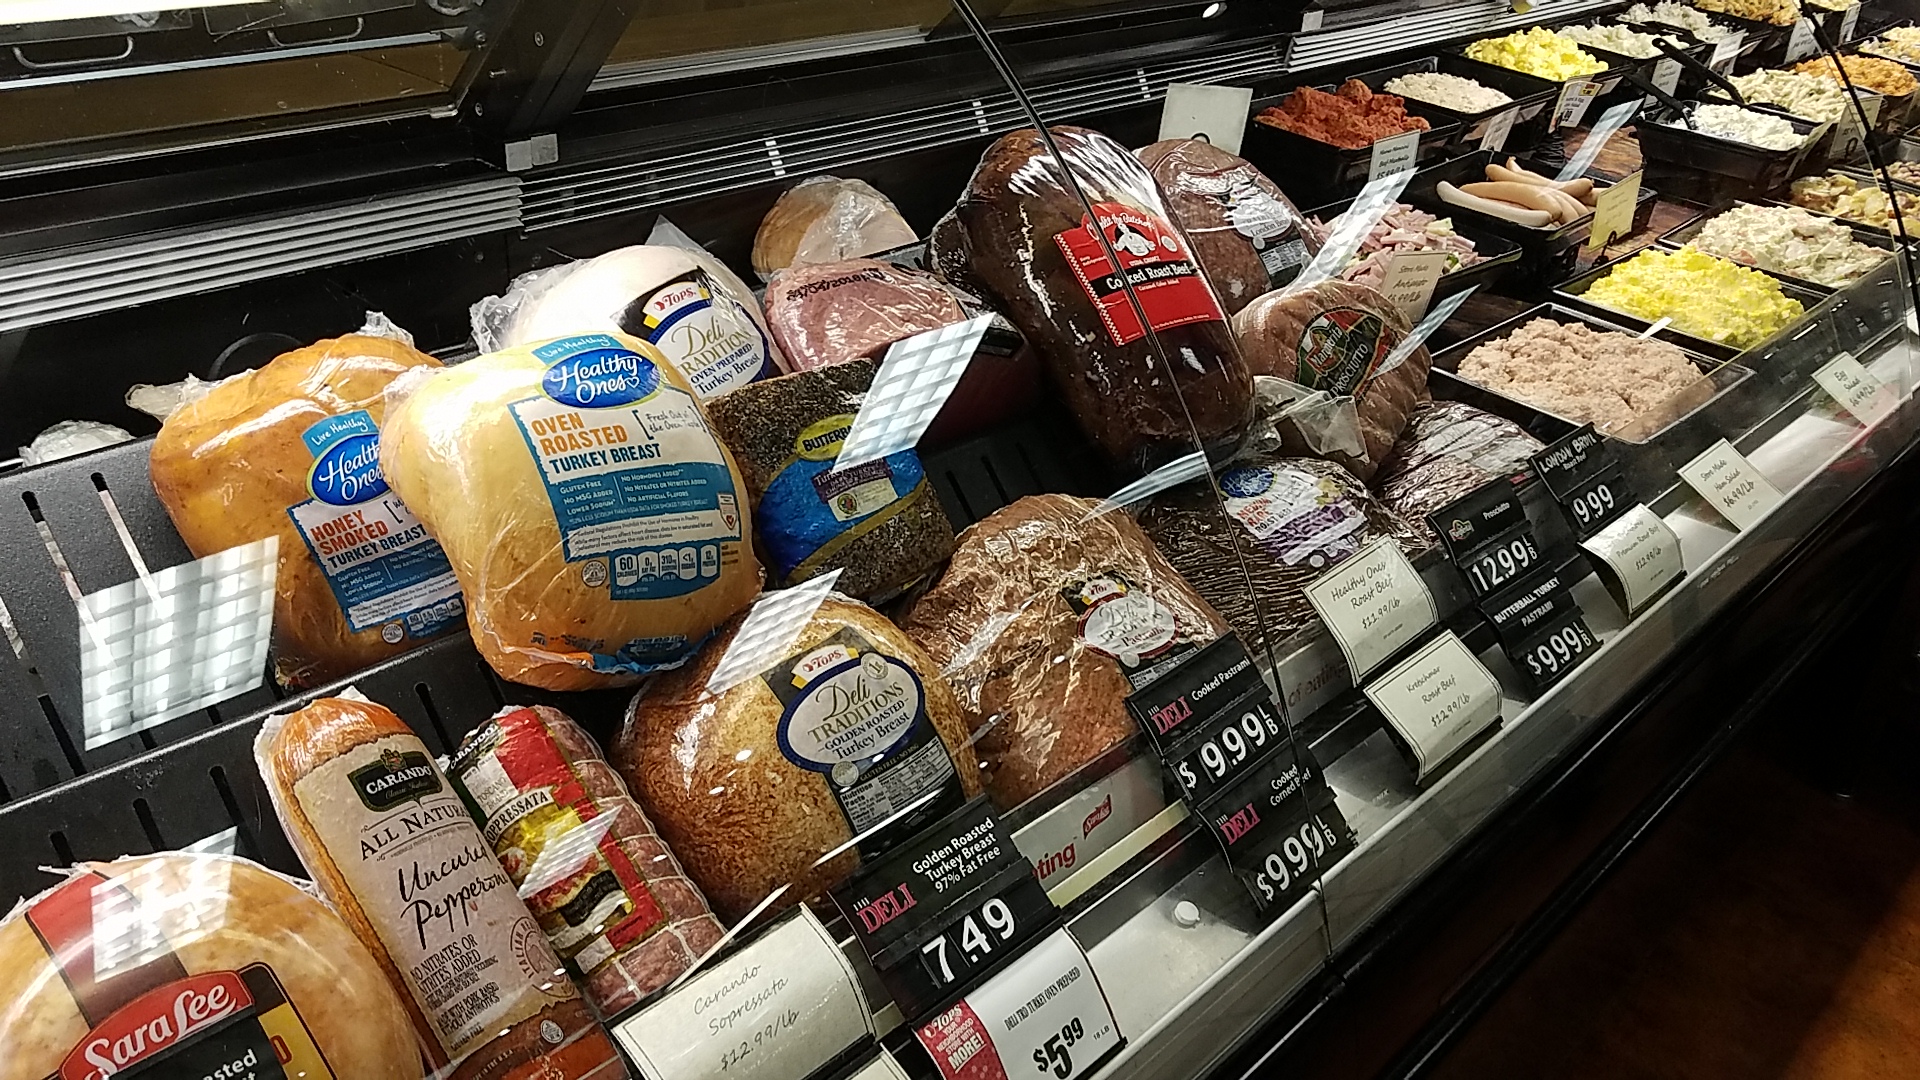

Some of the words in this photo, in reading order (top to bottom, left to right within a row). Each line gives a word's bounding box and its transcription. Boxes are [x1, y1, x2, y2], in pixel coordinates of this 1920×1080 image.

[1250, 223, 1277, 238] London
[1106, 269, 1147, 290] Coked
[1145, 265, 1173, 280] Roast
[1170, 262, 1192, 277] Beef
[541, 345, 562, 358] Live
[671, 315, 725, 361] Deli
[677, 330, 753, 376] RADITION
[550, 355, 643, 392] Healthy
[690, 365, 716, 385] OVEN
[716, 344, 753, 371] PREPARED
[695, 369, 735, 395] Turkey
[735, 352, 762, 374] Breast
[1329, 342, 1369, 399] PROSCIUTTO
[575, 376, 627, 404] Ones
[311, 431, 331, 446] Live
[531, 412, 585, 437] OVEN
[538, 424, 628, 457] ROASTED
[802, 425, 853, 452] BUTTERB
[318, 437, 380, 493] Healt
[548, 451, 609, 475] TURKEY
[612, 443, 662, 464] BREAST
[1539, 445, 1574, 474] LONDON
[1572, 432, 1597, 453] BROIL
[341, 464, 386, 501] Ones
[1714, 476, 1729, 493] Ham
[1483, 502, 1510, 520] Prosciutto
[1573, 484, 1615, 524] 9.99
[310, 509, 365, 542] HONEY
[319, 520, 389, 556] SMOKED
[327, 542, 380, 570] TURKEY
[381, 524, 427, 551] BREAST
[619, 556, 632, 572] 60
[1471, 540, 1529, 592] 12.99
[1330, 575, 1366, 601] Healthy
[1366, 561, 1387, 579] Ones
[1350, 587, 1375, 610] Roast
[1374, 574, 1394, 593] Beef
[1493, 593, 1536, 624] BUTTERBALL
[1532, 576, 1561, 602] TURKEY
[1520, 600, 1555, 627] PASTRAMI
[1526, 626, 1584, 676] $9.99
[815, 674, 871, 722] Deli
[1191, 675, 1220, 702] Cooked
[1217, 657, 1252, 685] Pastrami
[1406, 665, 1441, 694] Kretschmar
[1421, 686, 1442, 704] Roast
[1440, 673, 1457, 692] Beef
[807, 681, 905, 744] TRADITIONS
[824, 724, 866, 752] GOLDEN
[867, 699, 905, 731] ROASTED
[1151, 696, 1193, 736] DELI
[450, 722, 497, 770] CARANDO
[832, 733, 876, 760] Turkey
[876, 710, 911, 739] Breast
[365, 764, 433, 796] CARANDO
[476, 776, 508, 804] TOSCANO
[841, 781, 875, 802] Nutrition
[1270, 781, 1298, 807] Corned
[1271, 763, 1299, 791] Cooked
[845, 795, 867, 809] Facts
[360, 826, 401, 862] ALL
[399, 804, 470, 836] NATURA
[1219, 802, 1261, 846] DELI
[912, 844, 954, 875] Golden
[950, 817, 996, 850] Roasted
[924, 854, 964, 883] Turkey
[961, 832, 998, 861] Breast
[1256, 821, 1326, 902] $9.99
[398, 832, 493, 903] Uncured
[934, 871, 961, 894] 97%
[958, 858, 979, 879] Fat
[976, 846, 1002, 867] Free
[399, 867, 509, 950] Pepperoni
[856, 882, 918, 935] DELI
[410, 966, 424, 984] NO
[420, 941, 463, 977] NITRATES
[461, 933, 479, 951] OR
[921, 897, 1016, 984] 7.49
[417, 965, 452, 998] NITRITES
[450, 949, 482, 976] ADDED
[693, 963, 763, 1017] Carando
[463, 991, 481, 1010] PORK
[479, 981, 500, 998] RAISED
[464, 994, 501, 1021] ANTIBIOTICS
[708, 976, 790, 1038] Sopressata
[1003, 1012, 1020, 1032] DELI
[1026, 993, 1048, 1015] TURKEY
[1044, 984, 1060, 1001] OVEN
[1055, 966, 1082, 992] PREPARED
[84, 1013, 174, 1080] Sara
[172, 984, 238, 1042] Lee
[935, 1017, 974, 1054] NEIGHBORHOOD
[942, 1021, 958, 1036] YOUR
[945, 1039, 963, 1056] STORE
[960, 1027, 976, 1047] WITH
[202, 1048, 259, 1080] sted
[947, 1031, 986, 1070] MORE!
